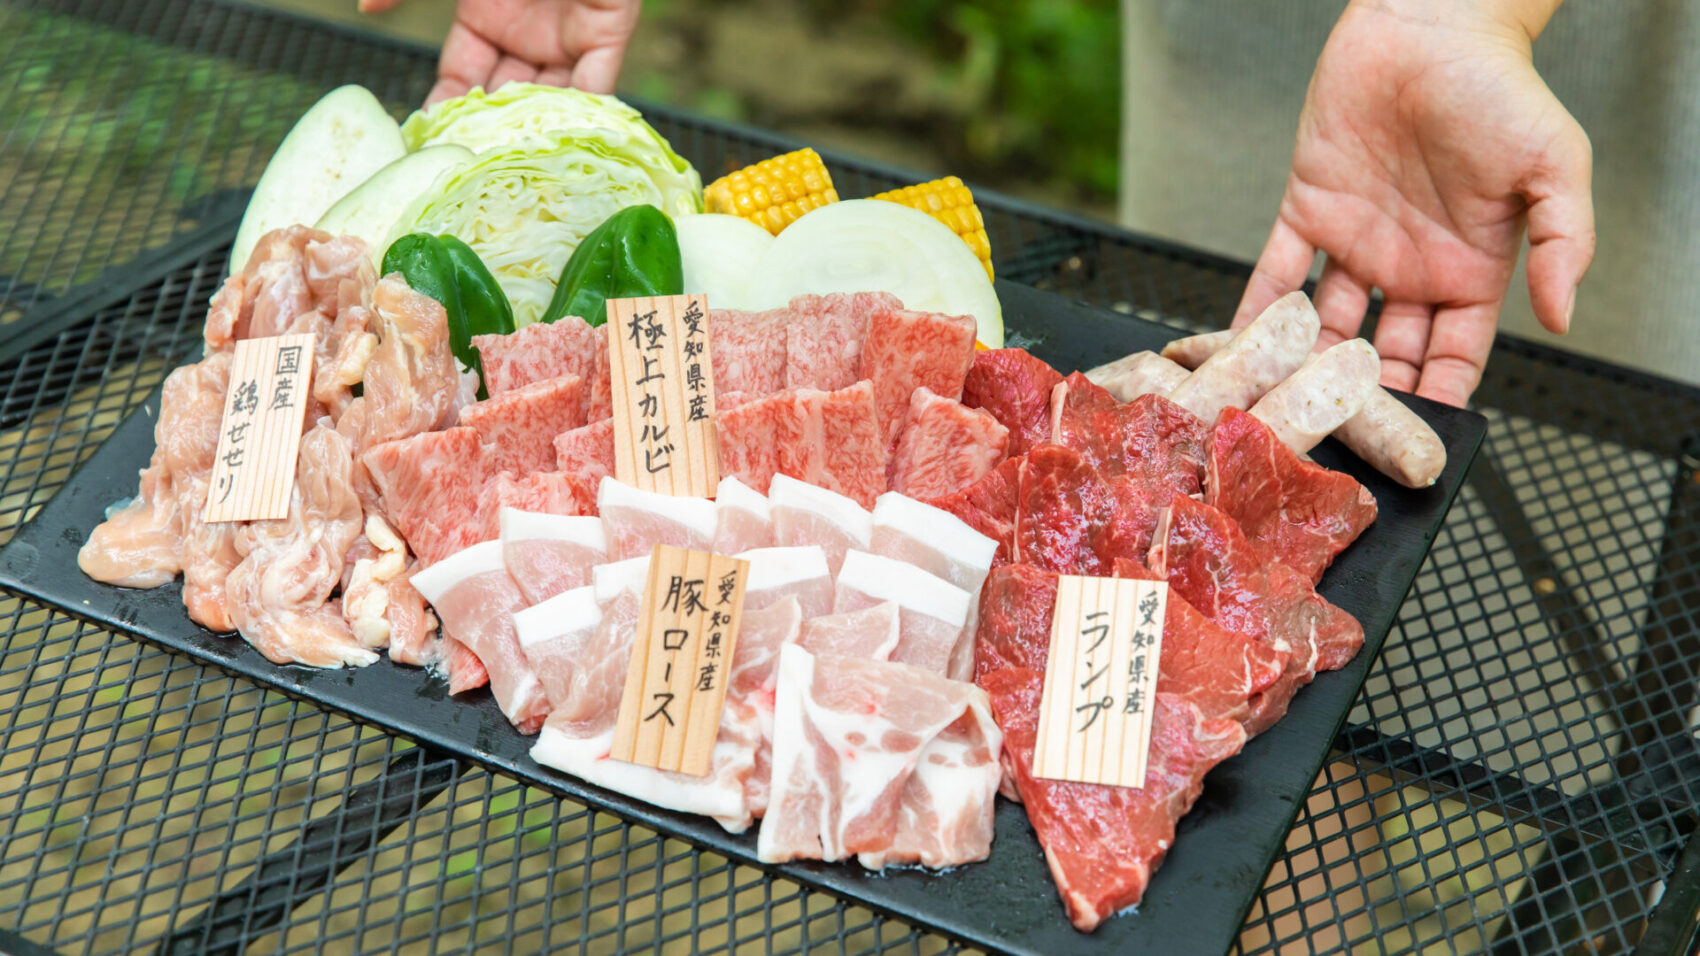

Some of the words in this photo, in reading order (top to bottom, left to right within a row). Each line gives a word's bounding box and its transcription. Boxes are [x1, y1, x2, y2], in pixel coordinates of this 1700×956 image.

[268, 345, 302, 410] 国産
[627, 310, 675, 474] 極上カルビ
[682, 300, 709, 422] 愛知県産
[218, 379, 259, 504] 鶏せせり
[643, 575, 709, 727] 豚ロース
[695, 570, 737, 692] 愛知県産
[1076, 612, 1114, 733] ランプ
[1122, 590, 1159, 714] 愛知県産
